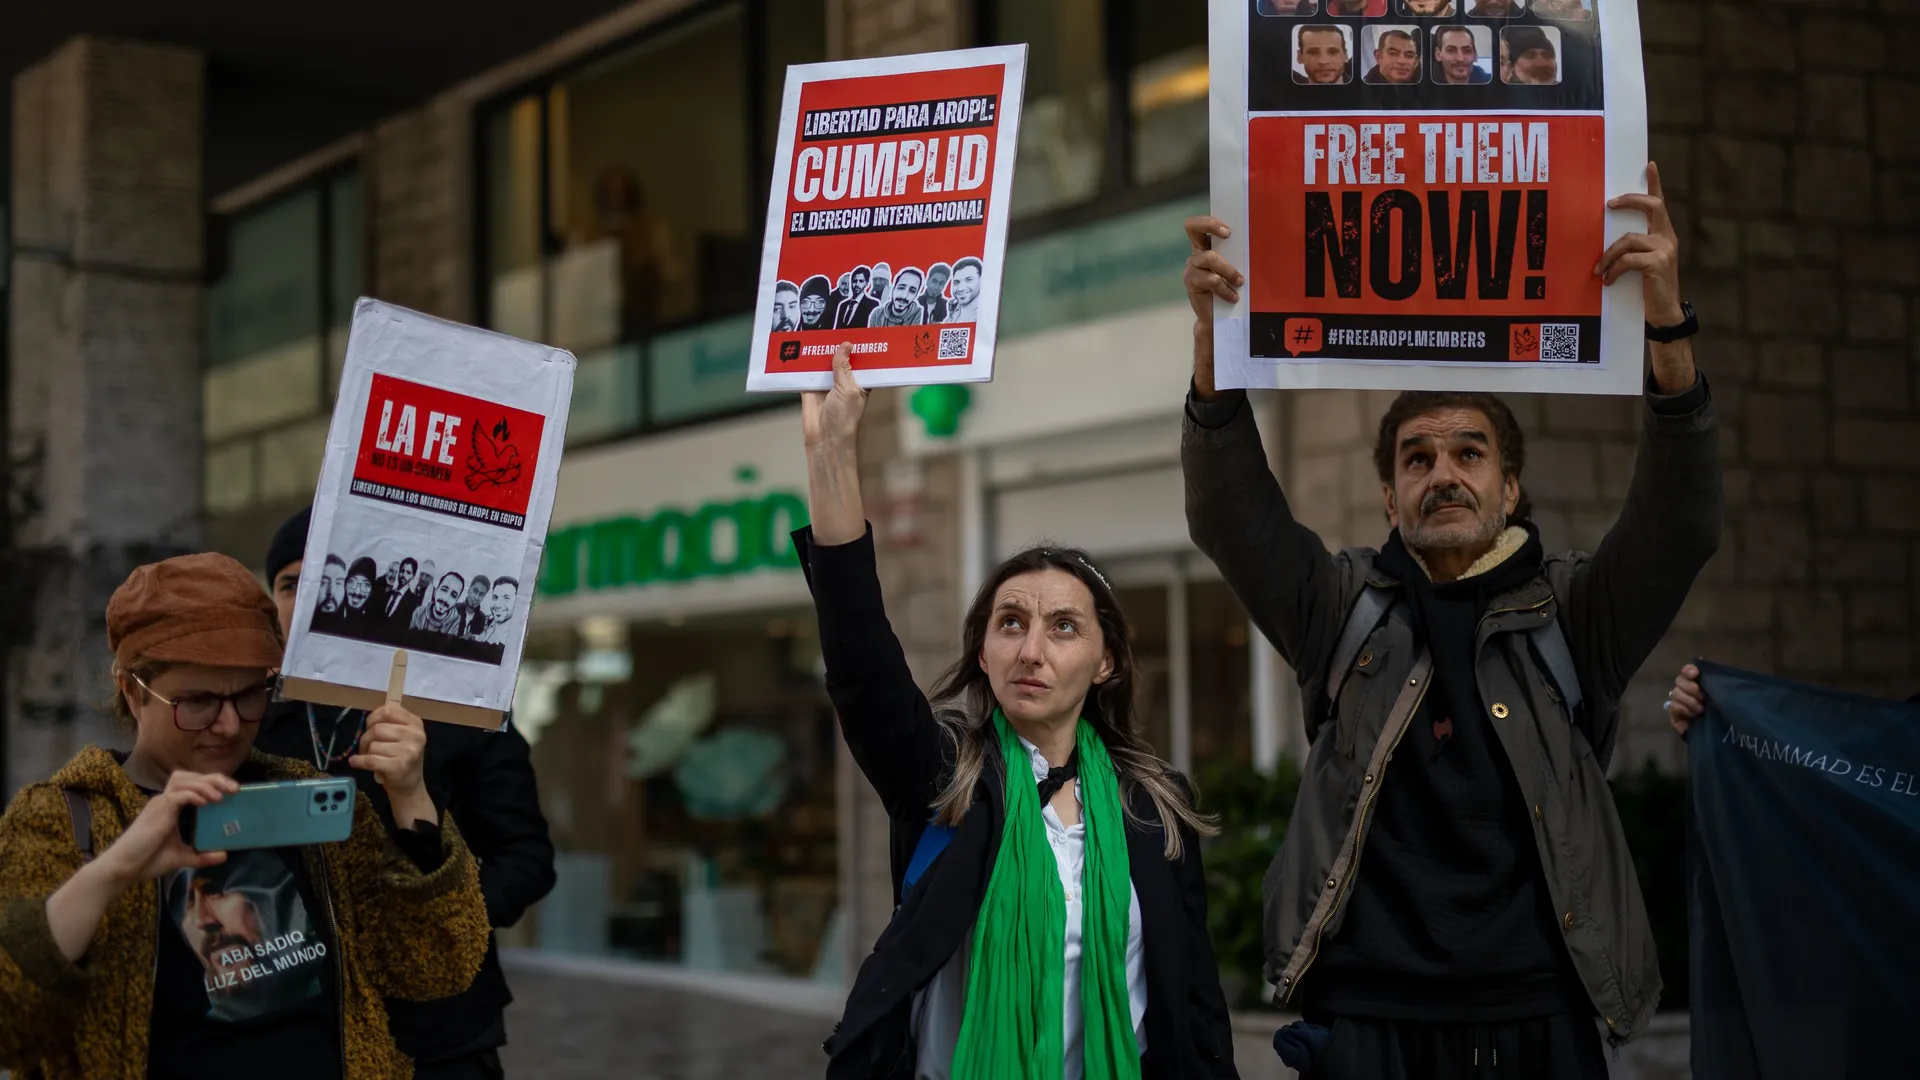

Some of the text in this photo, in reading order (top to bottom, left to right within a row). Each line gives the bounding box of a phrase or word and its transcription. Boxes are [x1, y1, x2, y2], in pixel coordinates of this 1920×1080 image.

[804, 98, 995, 136] LIBERTAD PARA AROPL:
[793, 134, 989, 203] CUMPLID
[1303, 122, 1549, 185] FREE THEM
[791, 200, 984, 232] EL DERECHO INTERNACIONAL
[1304, 189, 1548, 301] NOW!
[801, 342, 888, 356] #FREEARMEMBERS
[1328, 328, 1486, 348] #FREEAROPLMEMBERS
[375, 399, 462, 465] LA FE
[371, 452, 452, 482] NO ES UN CRIMEN
[352, 480, 523, 527] LIBERTAD PARA LOS MIEMBROS DE AROPL EN EGIPTO
[1855, 764, 1886, 787] ES
[1890, 771, 1919, 796] EL
[221, 930, 306, 966] ABA SADIQ
[205, 943, 327, 992] LUZ DEL MUNDO
